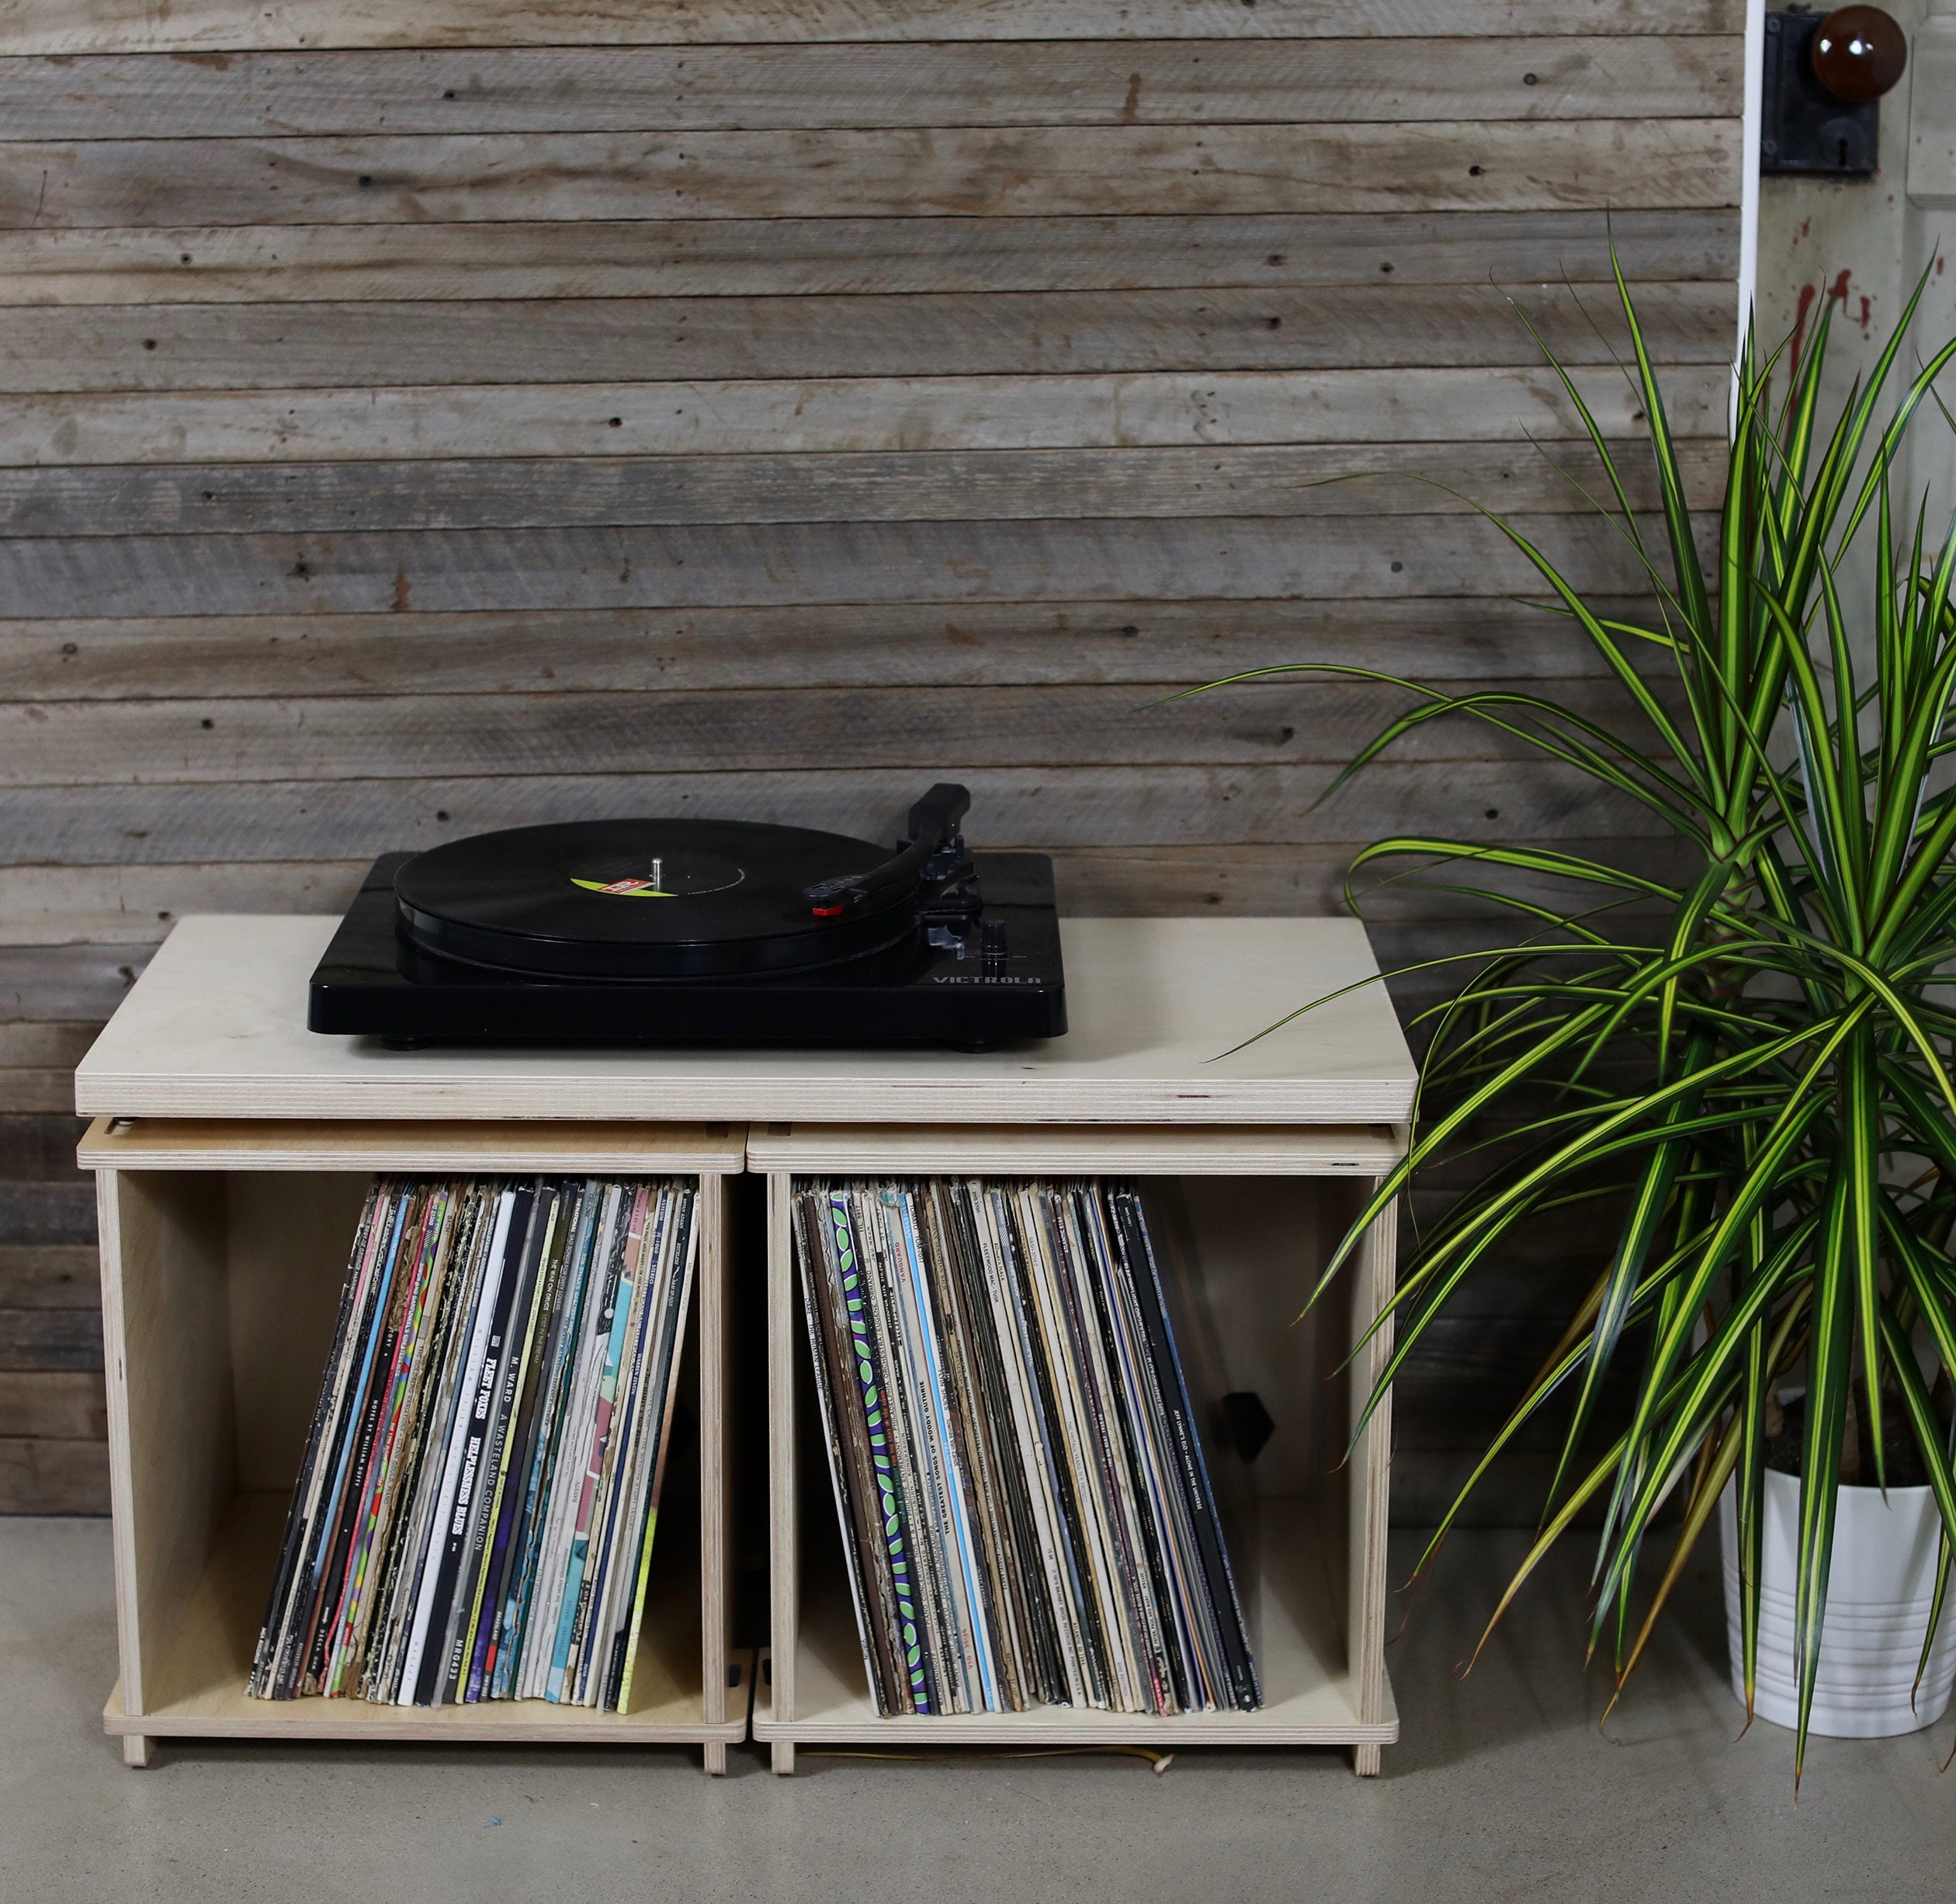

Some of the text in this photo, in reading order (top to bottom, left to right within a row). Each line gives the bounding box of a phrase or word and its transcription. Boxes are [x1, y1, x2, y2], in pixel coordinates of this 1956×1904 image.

[932, 976, 1042, 984] VICTROLA
[570, 1206, 580, 1233] NATIONAL
[550, 1258, 558, 1269] THE
[564, 1245, 573, 1264] SONGS
[893, 1241, 907, 1283] VANGUARD
[981, 1242, 994, 1275] FLEETWOOD
[547, 1269, 556, 1281] WAR
[987, 1275, 996, 1286] MAC
[542, 1292, 552, 1311] DRUGS
[384, 1327, 395, 1347] TORY
[501, 1372, 516, 1403] WARD
[918, 1381, 929, 1413] GUTHRIE
[367, 1399, 379, 1421] NOTES
[399, 1395, 412, 1431] VARIATIONS
[883, 1382, 899, 1431] PHILADELPHIA
[924, 1414, 935, 1442] WOODY
[358, 1434, 371, 1464] WILLIAM
[450, 1357, 498, 1535] FLEET FOXES HELPLESSNESS BLUES
[486, 1424, 506, 1486] WASTELAND
[1180, 1440, 1188, 1450] ELO
[893, 1437, 907, 1483] ENTREMONT
[931, 1455, 941, 1479] SONGS
[1183, 1454, 1194, 1471] ALONE
[352, 1465, 364, 1487] DUFTY
[1188, 1476, 1198, 1486] THE
[935, 1482, 947, 1518] GREATEST
[1191, 1486, 1203, 1510] UNIVERSE
[473, 1489, 494, 1551] COMPANION
[942, 1521, 950, 1535] THE
[914, 1560, 928, 1601] CONCERTOS
[921, 1604, 931, 1625] PIANO
[447, 1639, 464, 1680] MRG433
